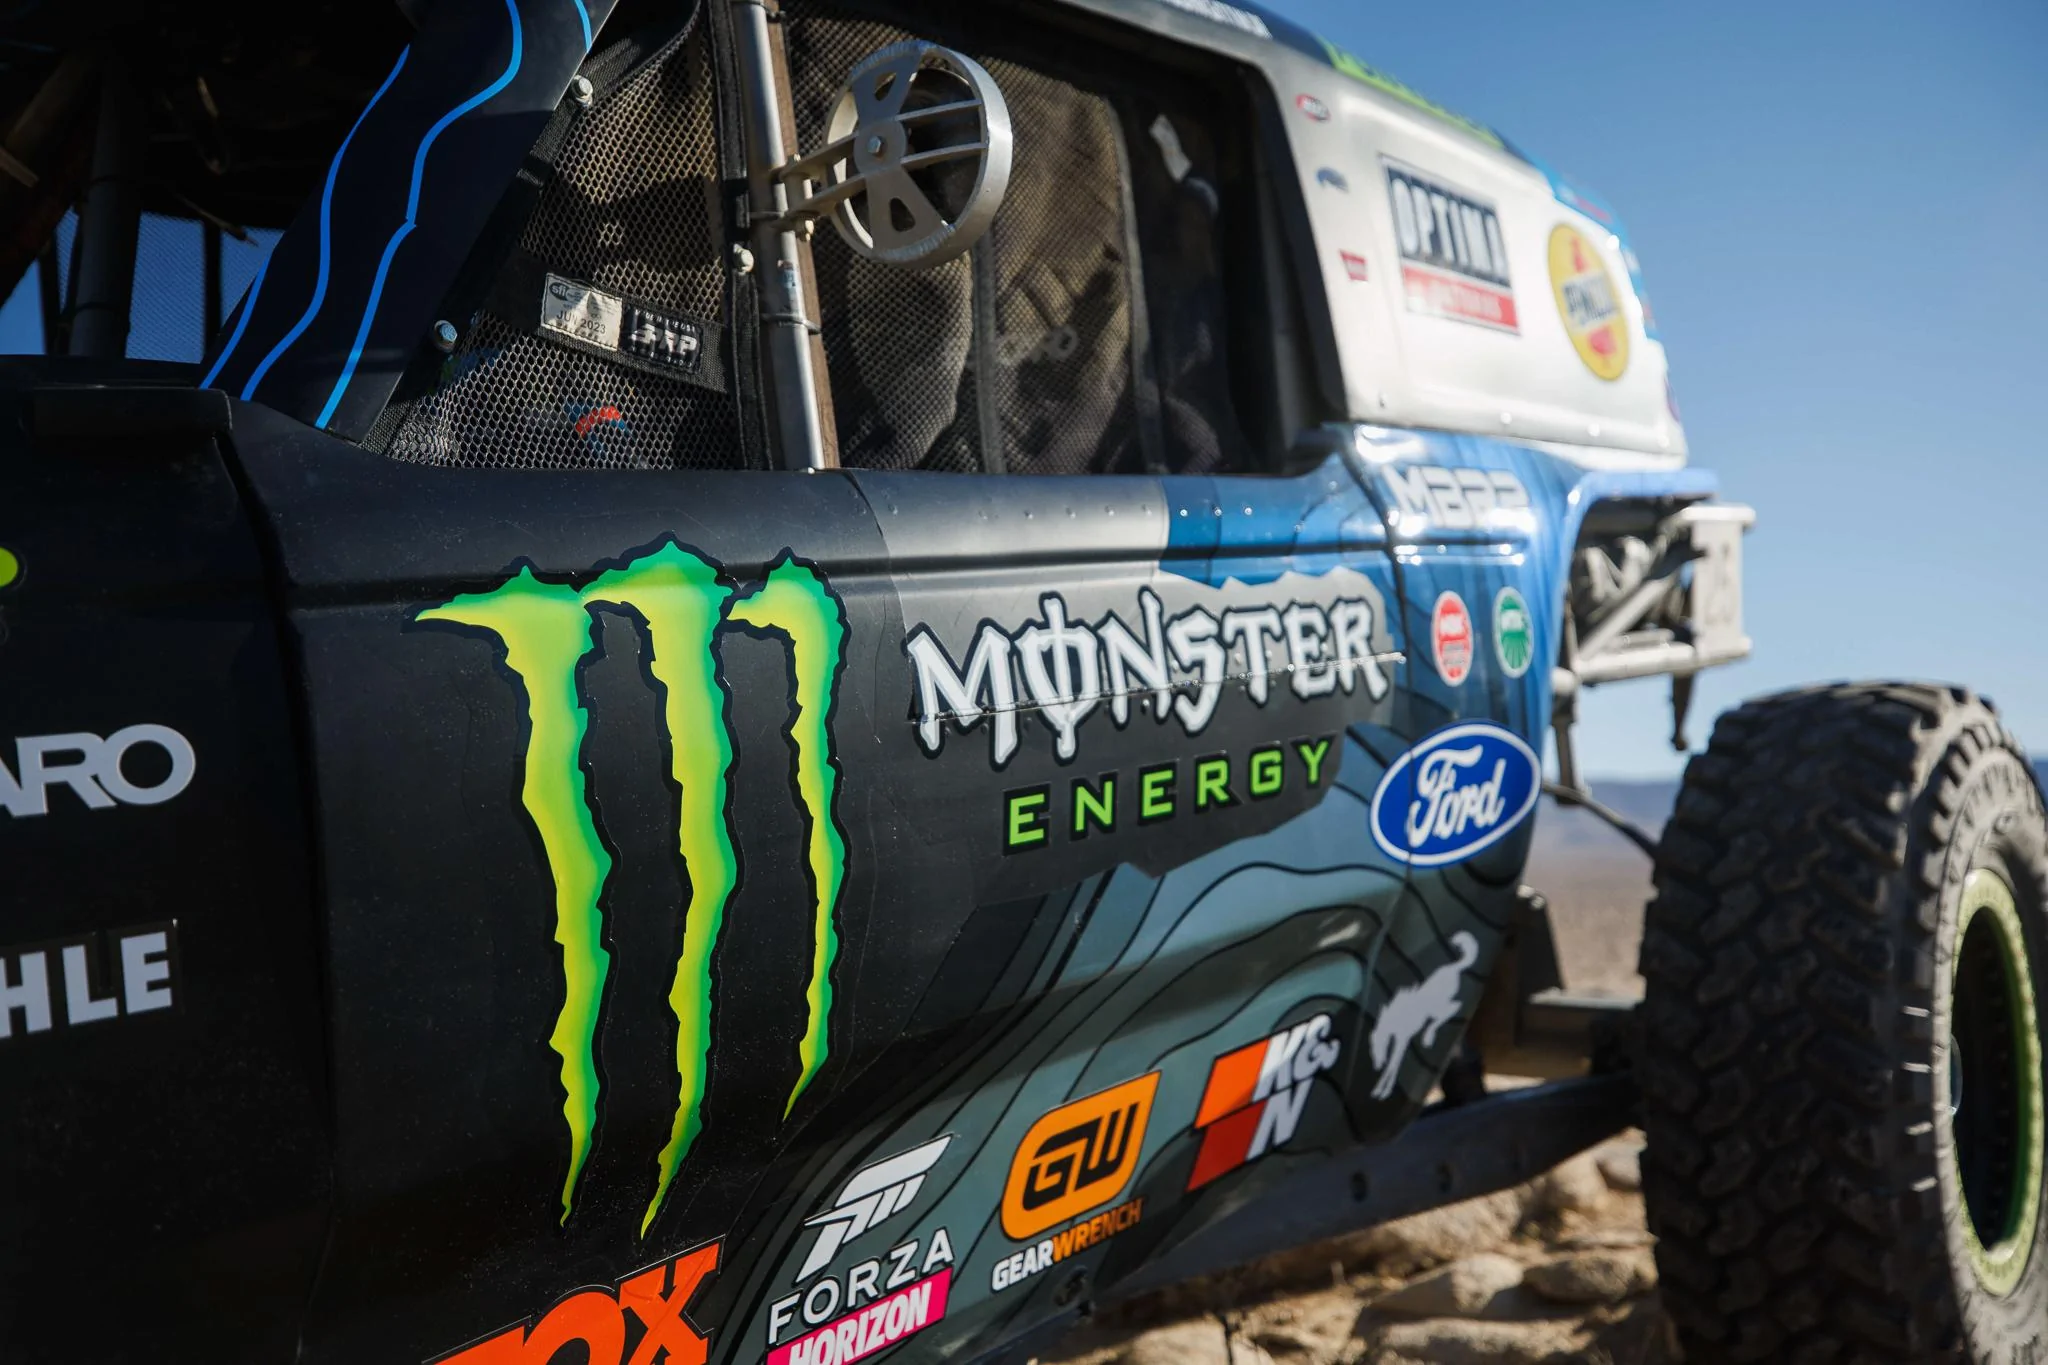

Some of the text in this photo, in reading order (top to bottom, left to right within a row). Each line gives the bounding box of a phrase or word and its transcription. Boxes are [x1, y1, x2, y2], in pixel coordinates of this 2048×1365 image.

[580, 318, 606, 335] 2023
[905, 586, 1388, 768] MONSTER
[1009, 740, 1329, 846] ENERGY
[1407, 744, 1507, 848] Ford
[0, 931, 172, 1038] HLE
[768, 1229, 954, 1345] FORZA
[991, 1198, 1142, 1292] GEARWRENCH
[432, 1242, 720, 1365] OX
